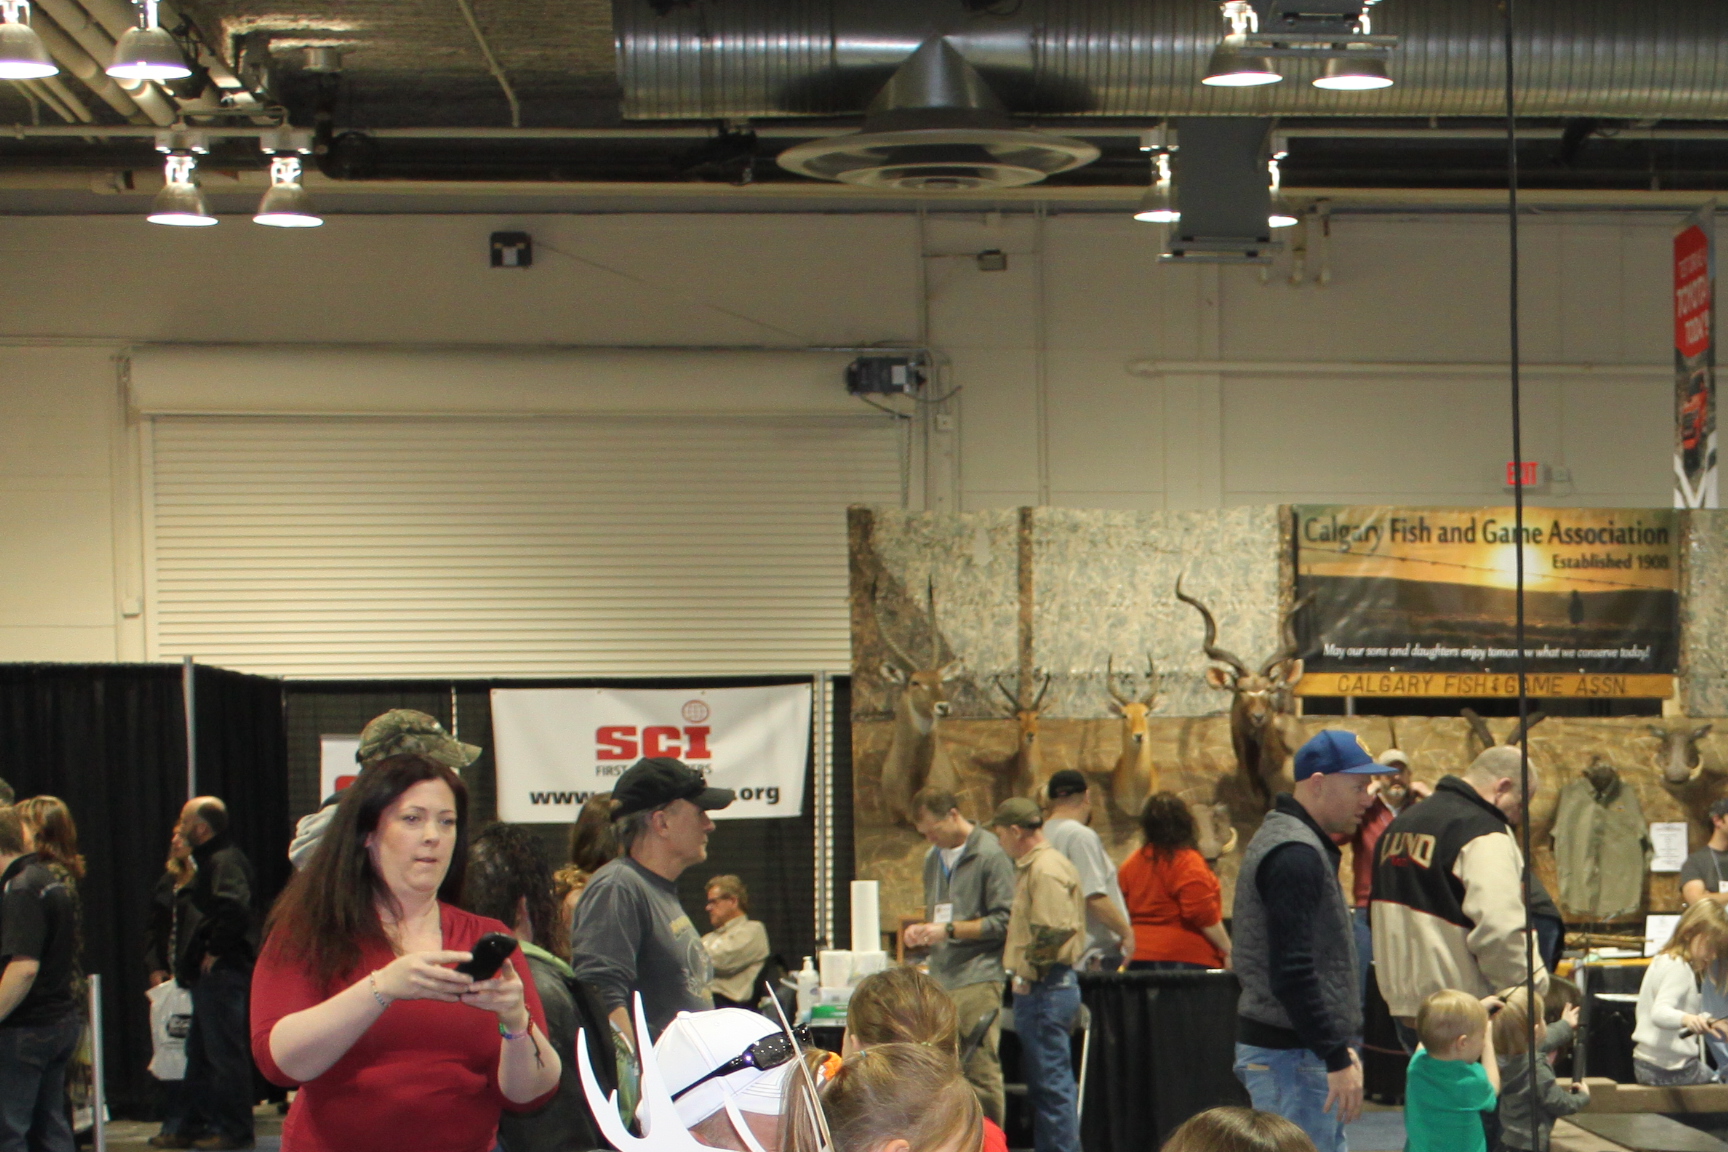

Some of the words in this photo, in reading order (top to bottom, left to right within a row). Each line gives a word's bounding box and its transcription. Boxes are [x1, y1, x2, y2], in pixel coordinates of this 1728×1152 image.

[1303, 514, 1385, 556] Calgary
[1390, 515, 1432, 543] Fish
[1437, 516, 1477, 544] and
[1548, 519, 1670, 545] Association
[1552, 553, 1634, 569] Established
[1323, 643, 1346, 660] May
[1346, 647, 1365, 657] our
[1365, 647, 1388, 657] sons
[1389, 643, 1410, 657] and
[1410, 643, 1460, 661] daughters
[1460, 645, 1487, 661] enjoy
[1535, 644, 1561, 658] what
[1562, 649, 1575, 658] we
[1577, 649, 1619, 658] conserve
[1337, 674, 1434, 694] CALGARY
[1443, 675, 1487, 694] FISH
[1575, 676, 1627, 695] ASSN
[595, 725, 712, 760] SCI
[1379, 832, 1436, 869] LUND
